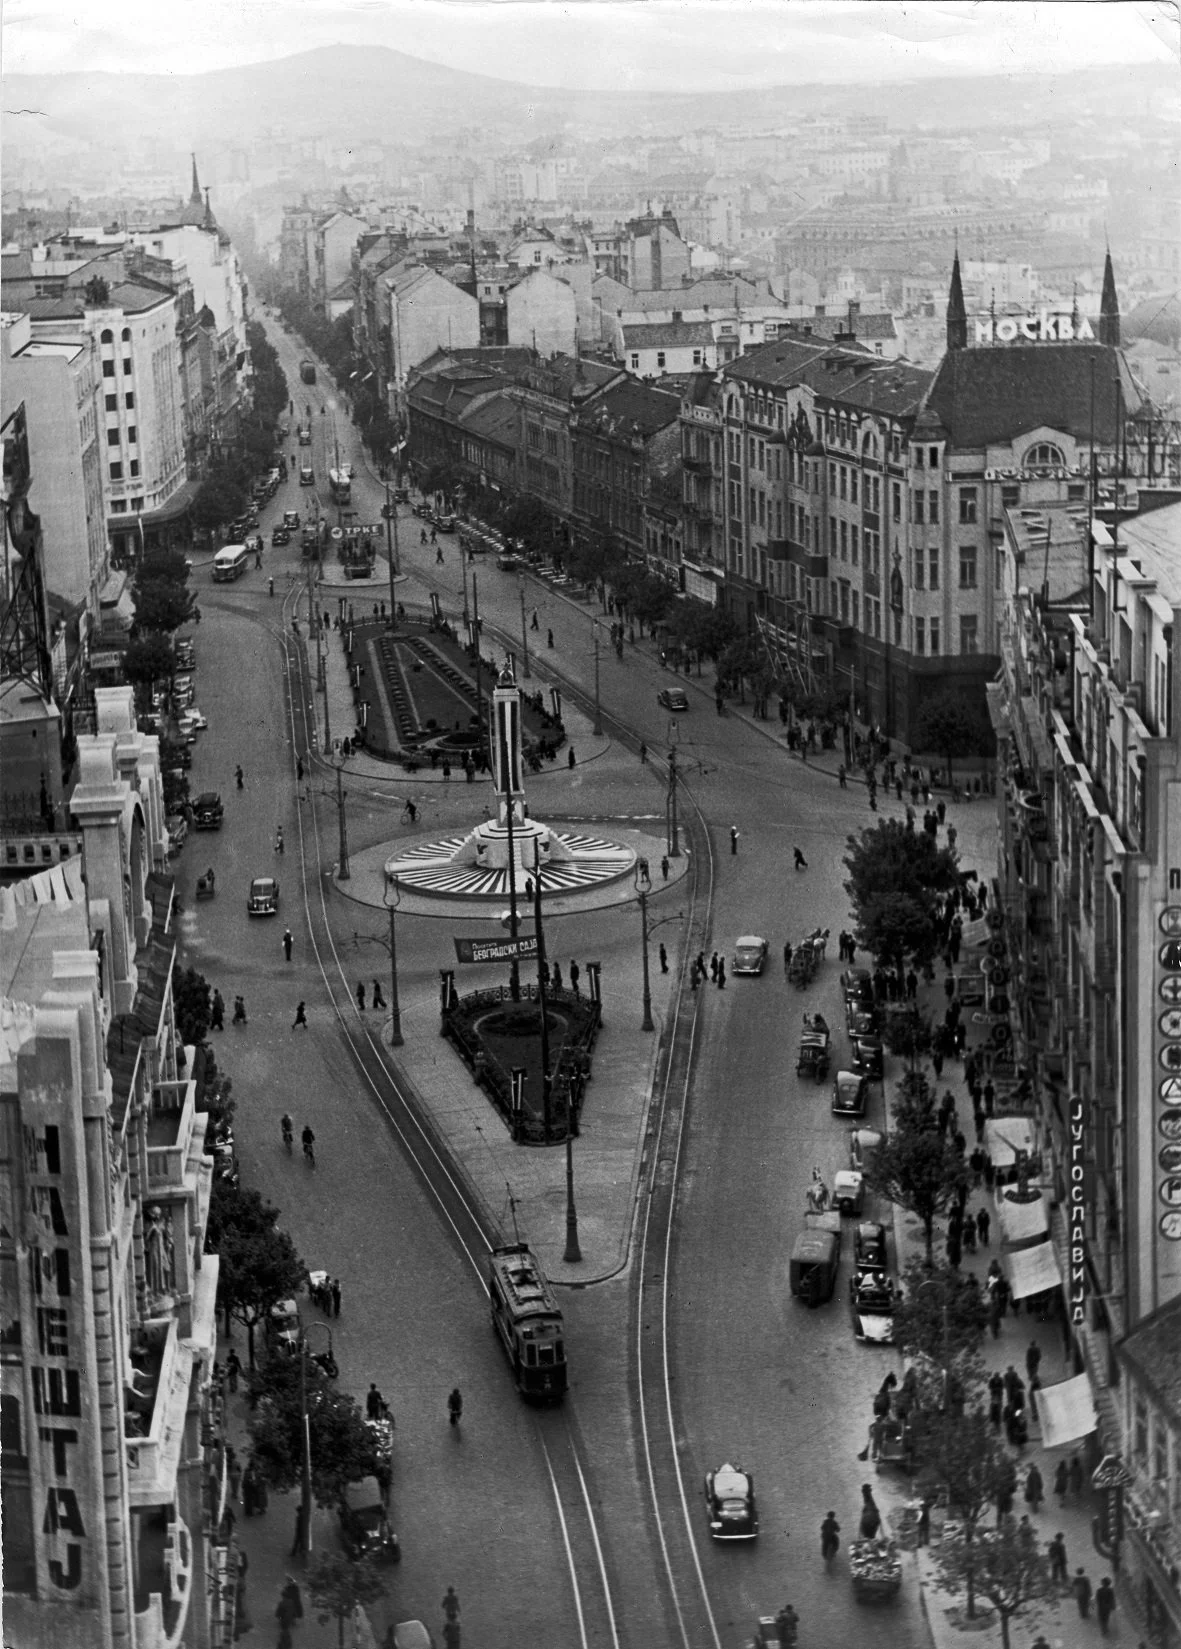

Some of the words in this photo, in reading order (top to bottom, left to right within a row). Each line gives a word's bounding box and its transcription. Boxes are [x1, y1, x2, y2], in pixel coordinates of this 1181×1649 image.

[975, 308, 1095, 342] МОСКВА
[473, 943, 518, 961] БЕОГРАДСКИ
[1071, 1103, 1084, 1320] ЈУГОСЛАВИЈА
